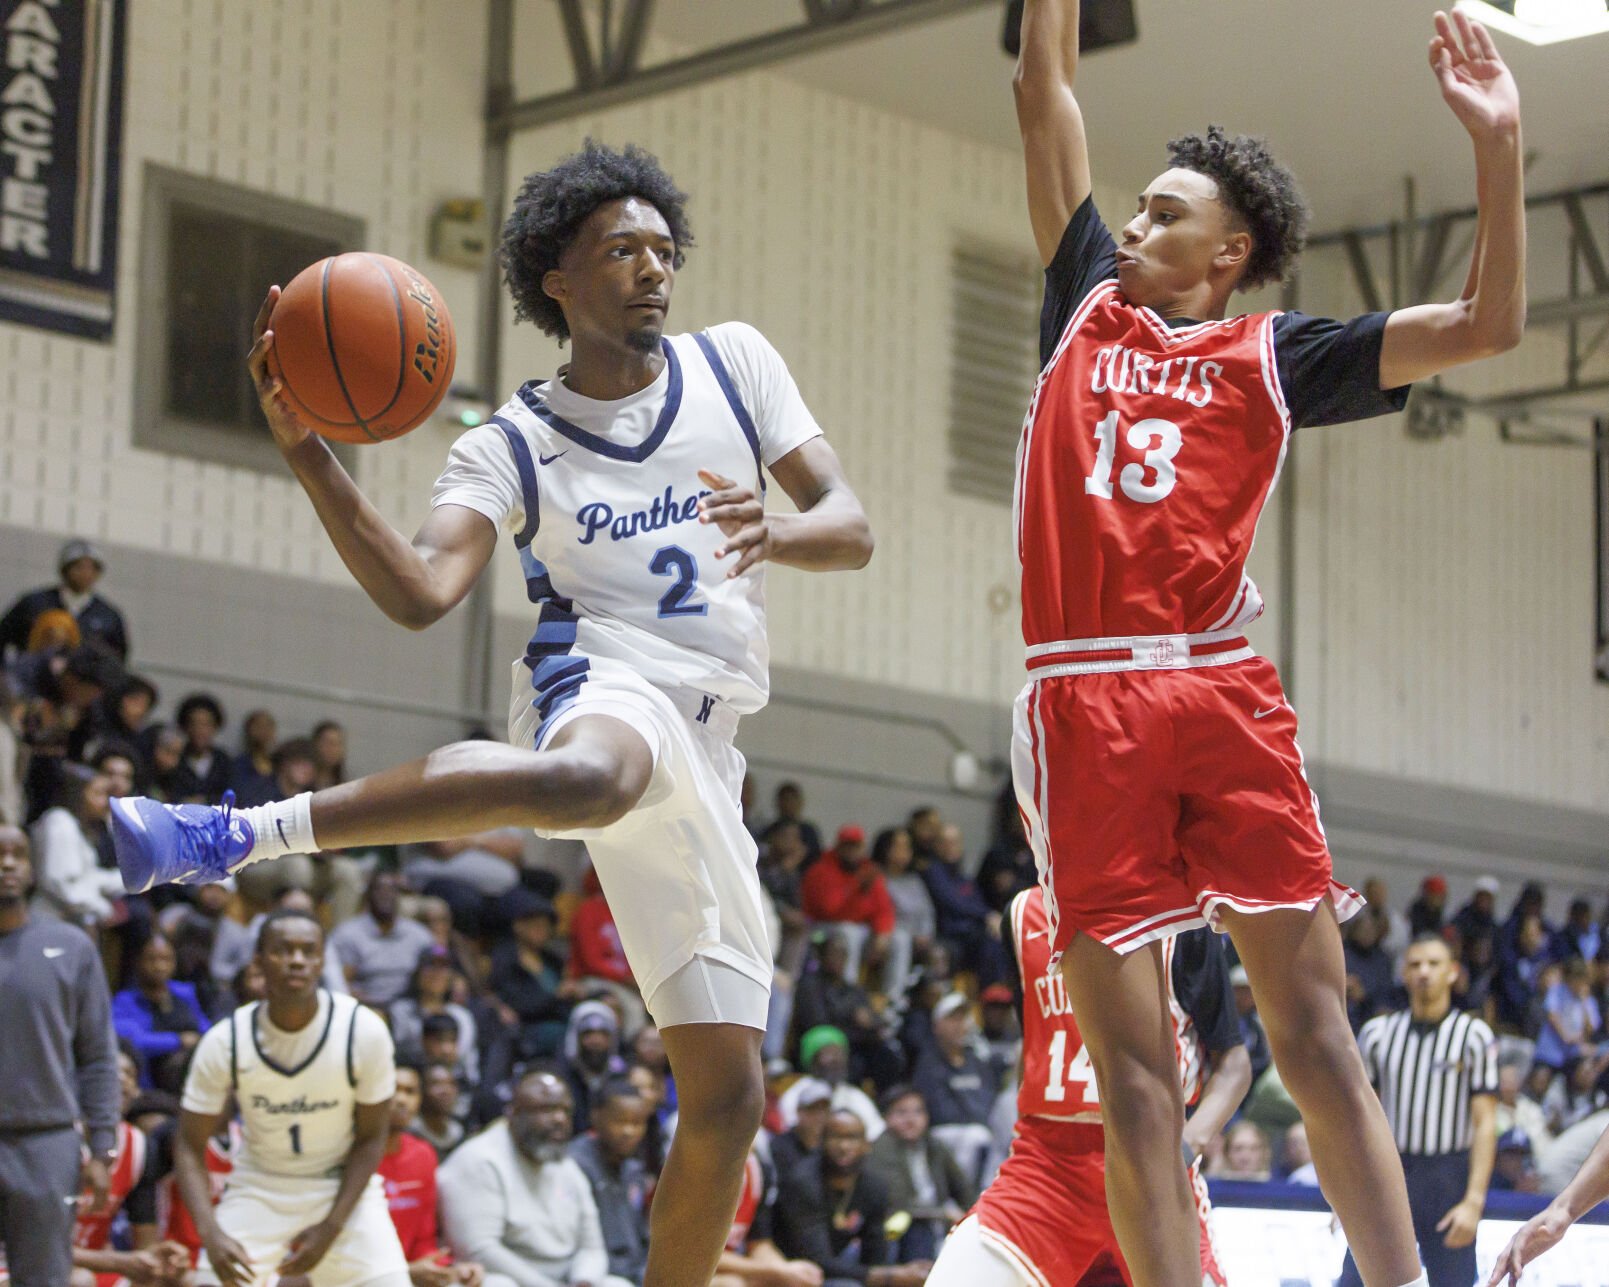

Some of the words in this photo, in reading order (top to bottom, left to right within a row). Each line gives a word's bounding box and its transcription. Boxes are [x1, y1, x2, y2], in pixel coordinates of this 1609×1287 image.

[0, 0, 61, 259] ARACTER
[1091, 344, 1223, 407] CURTIS
[1085, 410, 1183, 504] 13
[648, 544, 708, 619] 2
[696, 695, 715, 724] N
[1044, 1030, 1100, 1103] 14
[289, 1124, 302, 1154] 1
